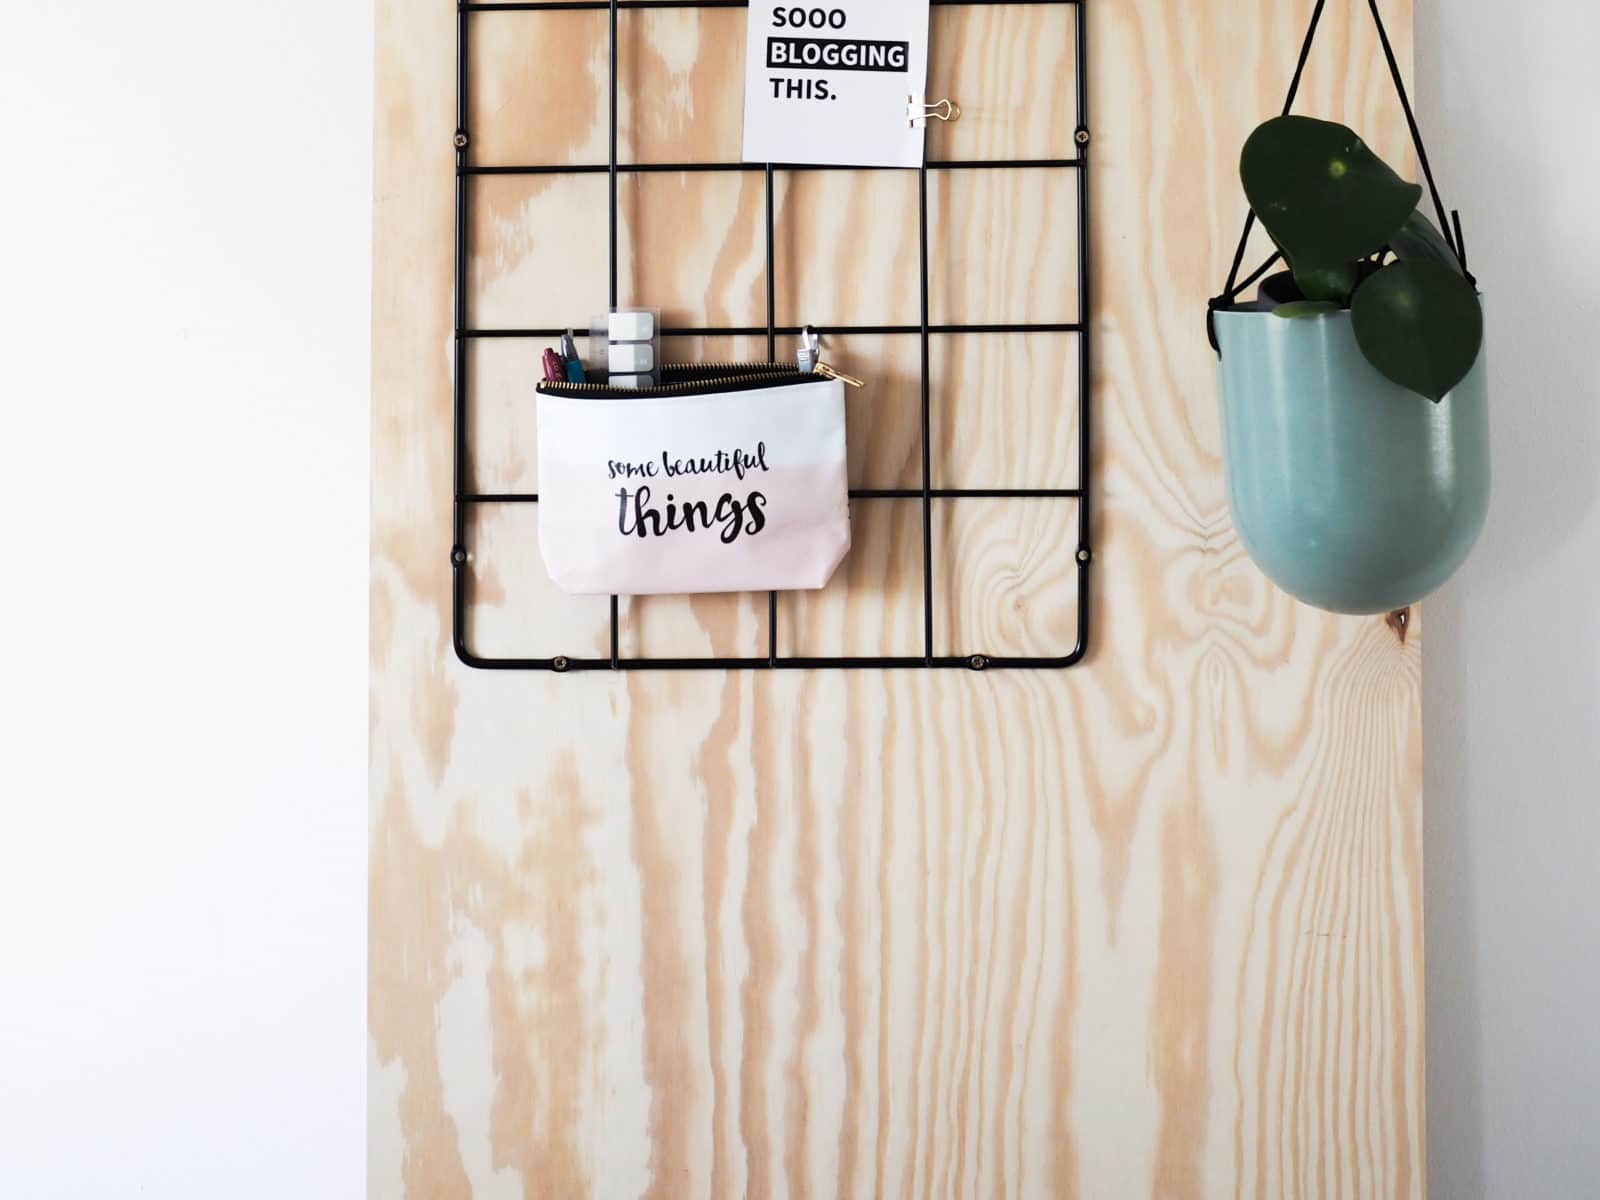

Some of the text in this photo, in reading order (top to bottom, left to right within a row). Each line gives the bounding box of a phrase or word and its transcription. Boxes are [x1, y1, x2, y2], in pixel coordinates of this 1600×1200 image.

[772, 6, 847, 29] SOOO
[770, 41, 905, 67] BLOGGING
[769, 77, 837, 101] THIS.
[607, 441, 769, 480] some beautiful
[614, 485, 767, 544] things
